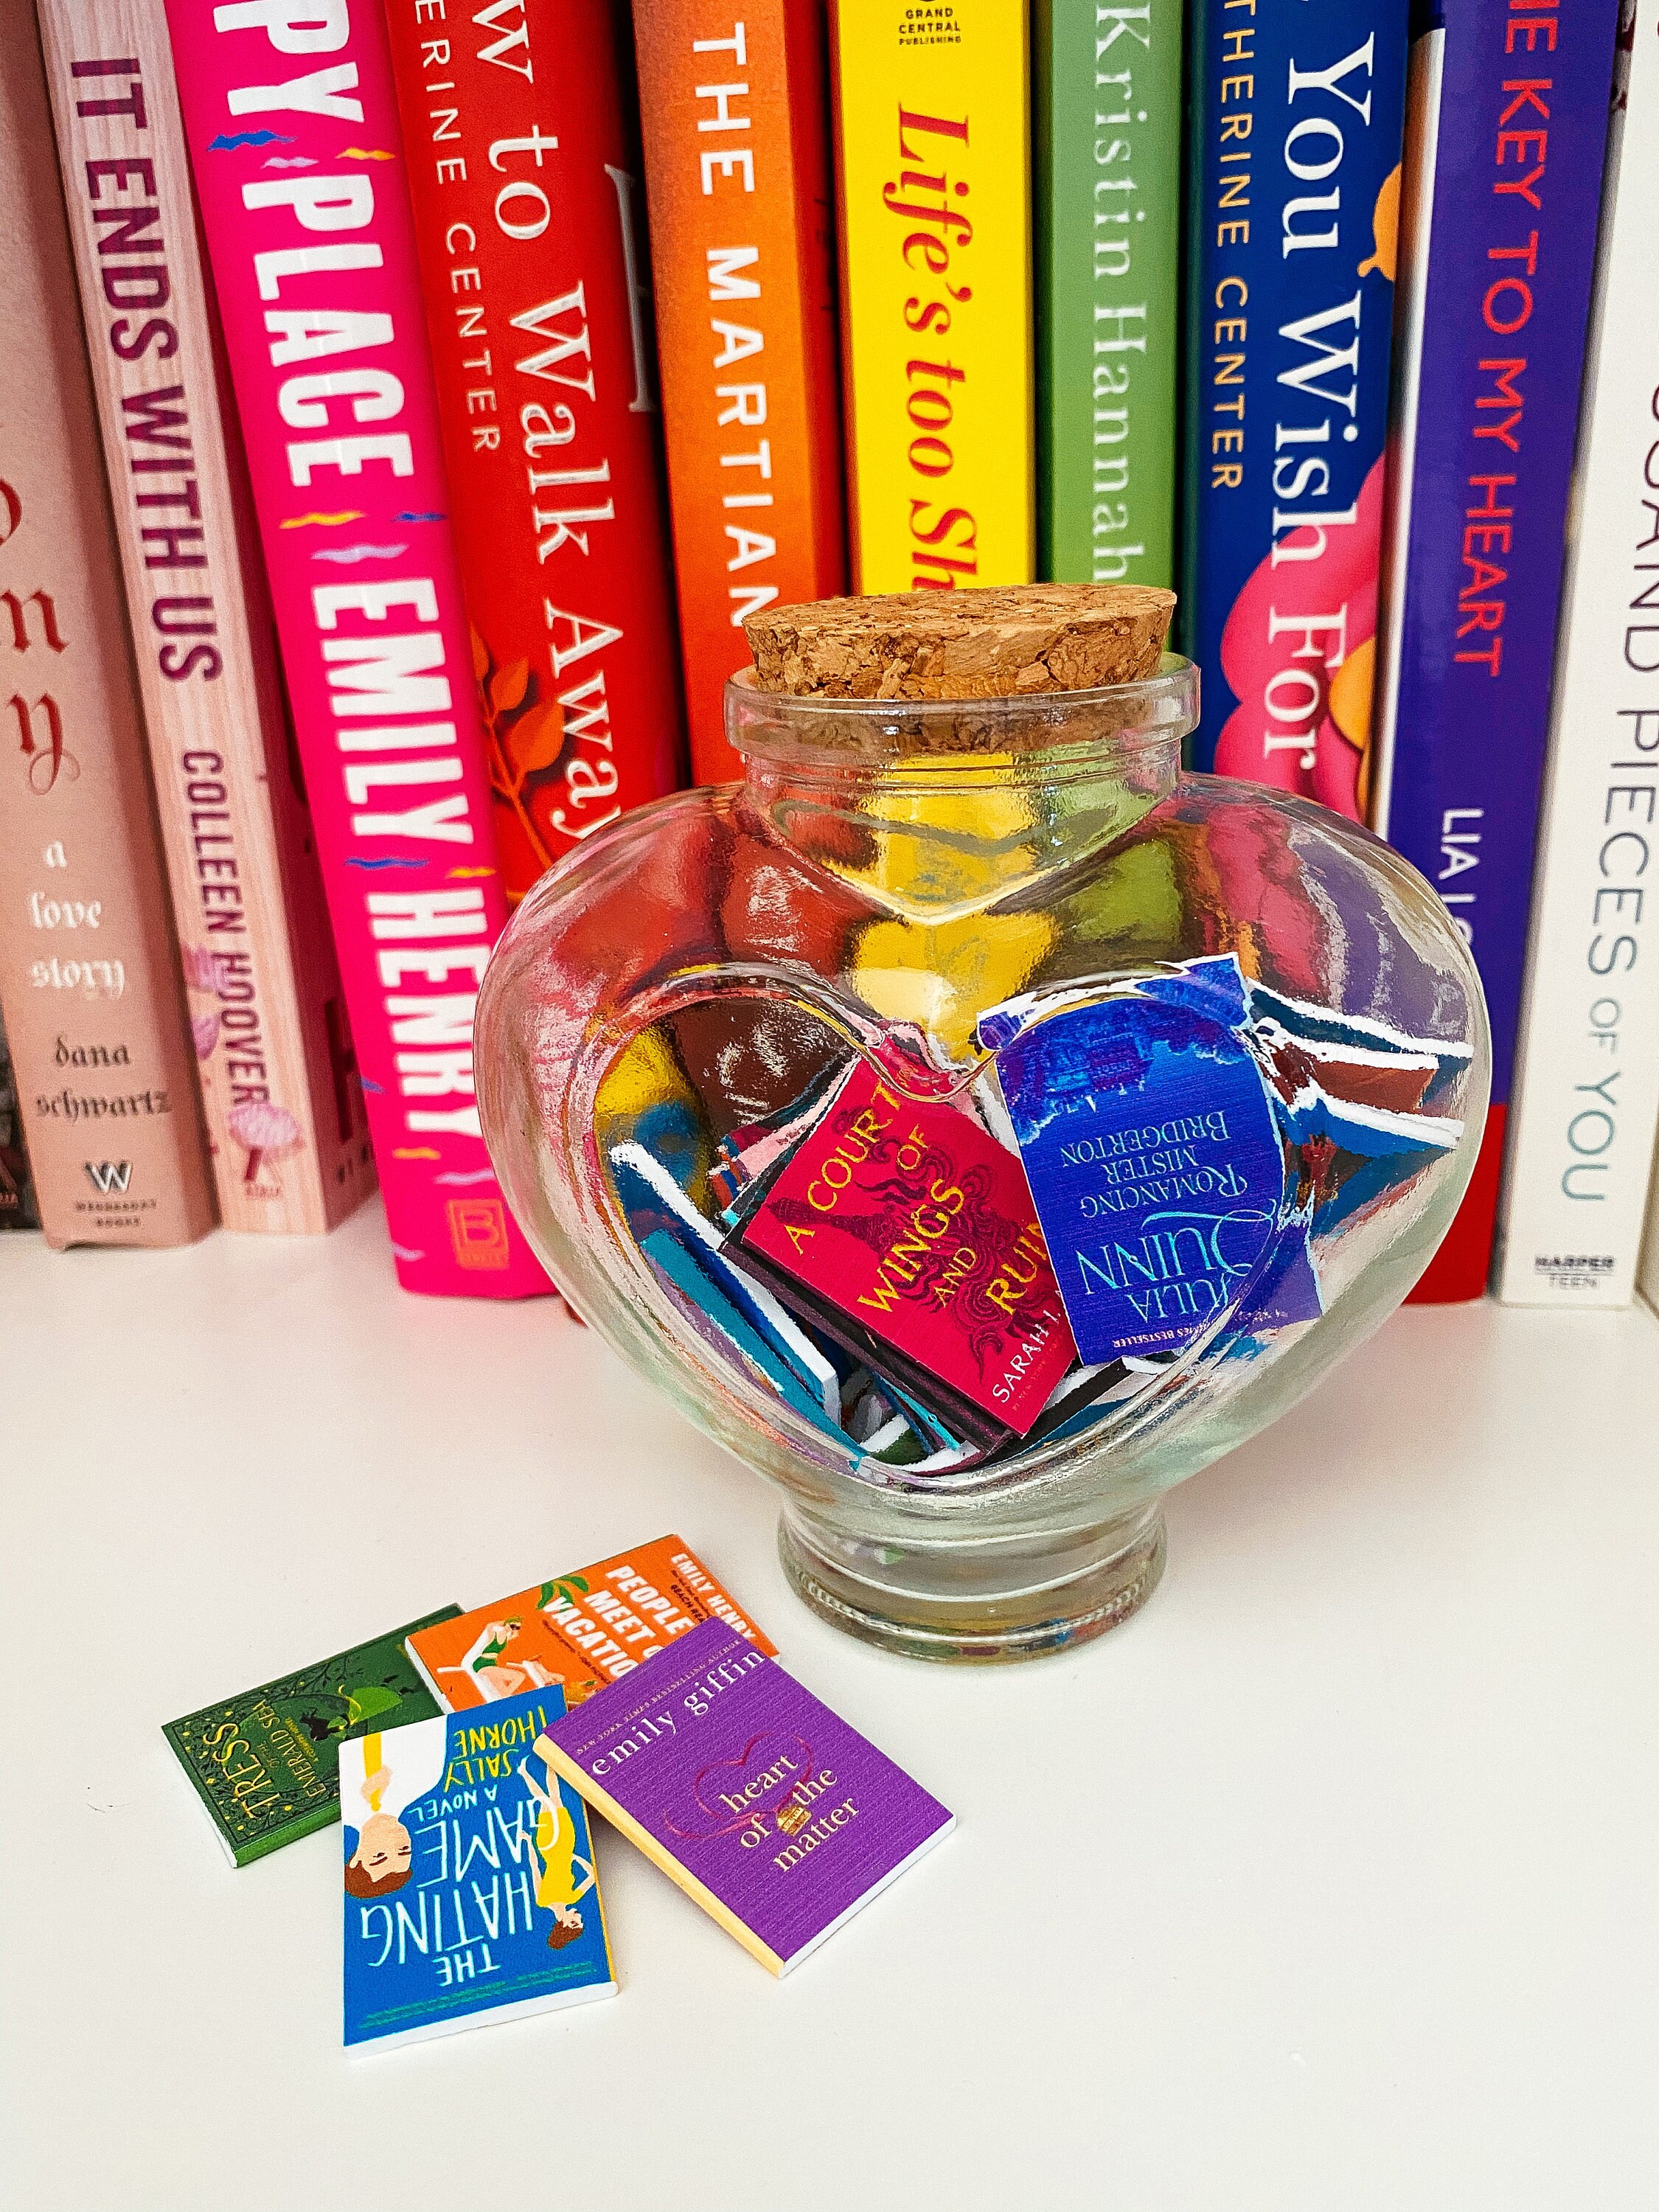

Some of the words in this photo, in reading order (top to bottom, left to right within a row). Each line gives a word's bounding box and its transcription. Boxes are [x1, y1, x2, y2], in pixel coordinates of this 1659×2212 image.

[899, 20, 961, 34] CENTRAL
[905, 7, 953, 19] GRAND
[72, 58, 147, 129] IT
[692, 22, 755, 195] THE
[487, 124, 559, 241] to
[1094, 3, 1152, 279] Kristin
[1281, 31, 1374, 259] You
[1495, 79, 1553, 211] KEY
[85, 158, 178, 360] ENDS
[883, 101, 973, 335] Life's
[1481, 230, 1539, 335] TO
[240, 174, 414, 487] PLACE
[445, 223, 501, 452] CENTER
[510, 280, 616, 565] Walk
[905, 359, 966, 479] too
[1211, 276, 1249, 489] CENTER
[1472, 358, 1527, 452] MY
[705, 246, 779, 627] MARTIAN
[1093, 303, 1148, 582] Hannah
[1270, 289, 1363, 571] Wish
[121, 385, 208, 570] WITH
[1454, 474, 1517, 677] HEART
[152, 597, 222, 681] US
[311, 577, 475, 844] EMILY
[1264, 602, 1347, 771] For
[46, 841, 68, 867] a
[1439, 808, 1484, 880] LIA
[1587, 709, 1659, 976] PIECES
[29, 893, 102, 931] love
[183, 751, 240, 933] COLLEEN
[212, 952, 269, 1105] HOOVER
[31, 958, 125, 1001] story
[367, 887, 492, 1138] HENRY
[55, 1032, 130, 1067] dana
[1588, 997, 1622, 1054] OF
[35, 1088, 171, 1124] schwartz
[895, 1123, 931, 1172] OF
[1060, 1111, 1232, 1168] BRIDGERTON
[1561, 1071, 1622, 1203] YOU
[83, 1159, 133, 1194] W
[782, 1222, 815, 1256] A
[807, 1080, 902, 1213] COURT
[1081, 1164, 1248, 1218] ROMANCING
[1105, 1145, 1197, 1186] MISTER
[856, 1178, 965, 1313] WINGS
[933, 1246, 977, 1308] AND
[1075, 1199, 1278, 1295] QUINN
[1112, 1330, 1175, 1348] BESTSELLER
[1127, 1272, 1229, 1324] JULIA
[992, 1323, 1049, 1403] SARAH
[583, 1590, 656, 1643] MEET
[605, 1565, 695, 1635] PEOPLE
[671, 1553, 715, 1593] EMILY
[706, 1594, 756, 1639] HENRY
[453, 1705, 548, 1761] THORNE
[592, 1710, 677, 1775] emily
[684, 1651, 765, 1716] giffin
[203, 1722, 280, 1819] TRESS
[270, 1730, 326, 1797] EMERALD
[408, 1791, 479, 1823] NOVEL
[443, 1748, 521, 1793] SALLY
[486, 1784, 498, 1802] A
[719, 1752, 799, 1815] heart
[739, 1813, 774, 1850] of
[793, 1767, 839, 1809] the
[414, 1795, 562, 1889] GAME
[772, 1795, 863, 1874] matter
[361, 1869, 534, 1968] HATING
[431, 1941, 502, 1987] THE
